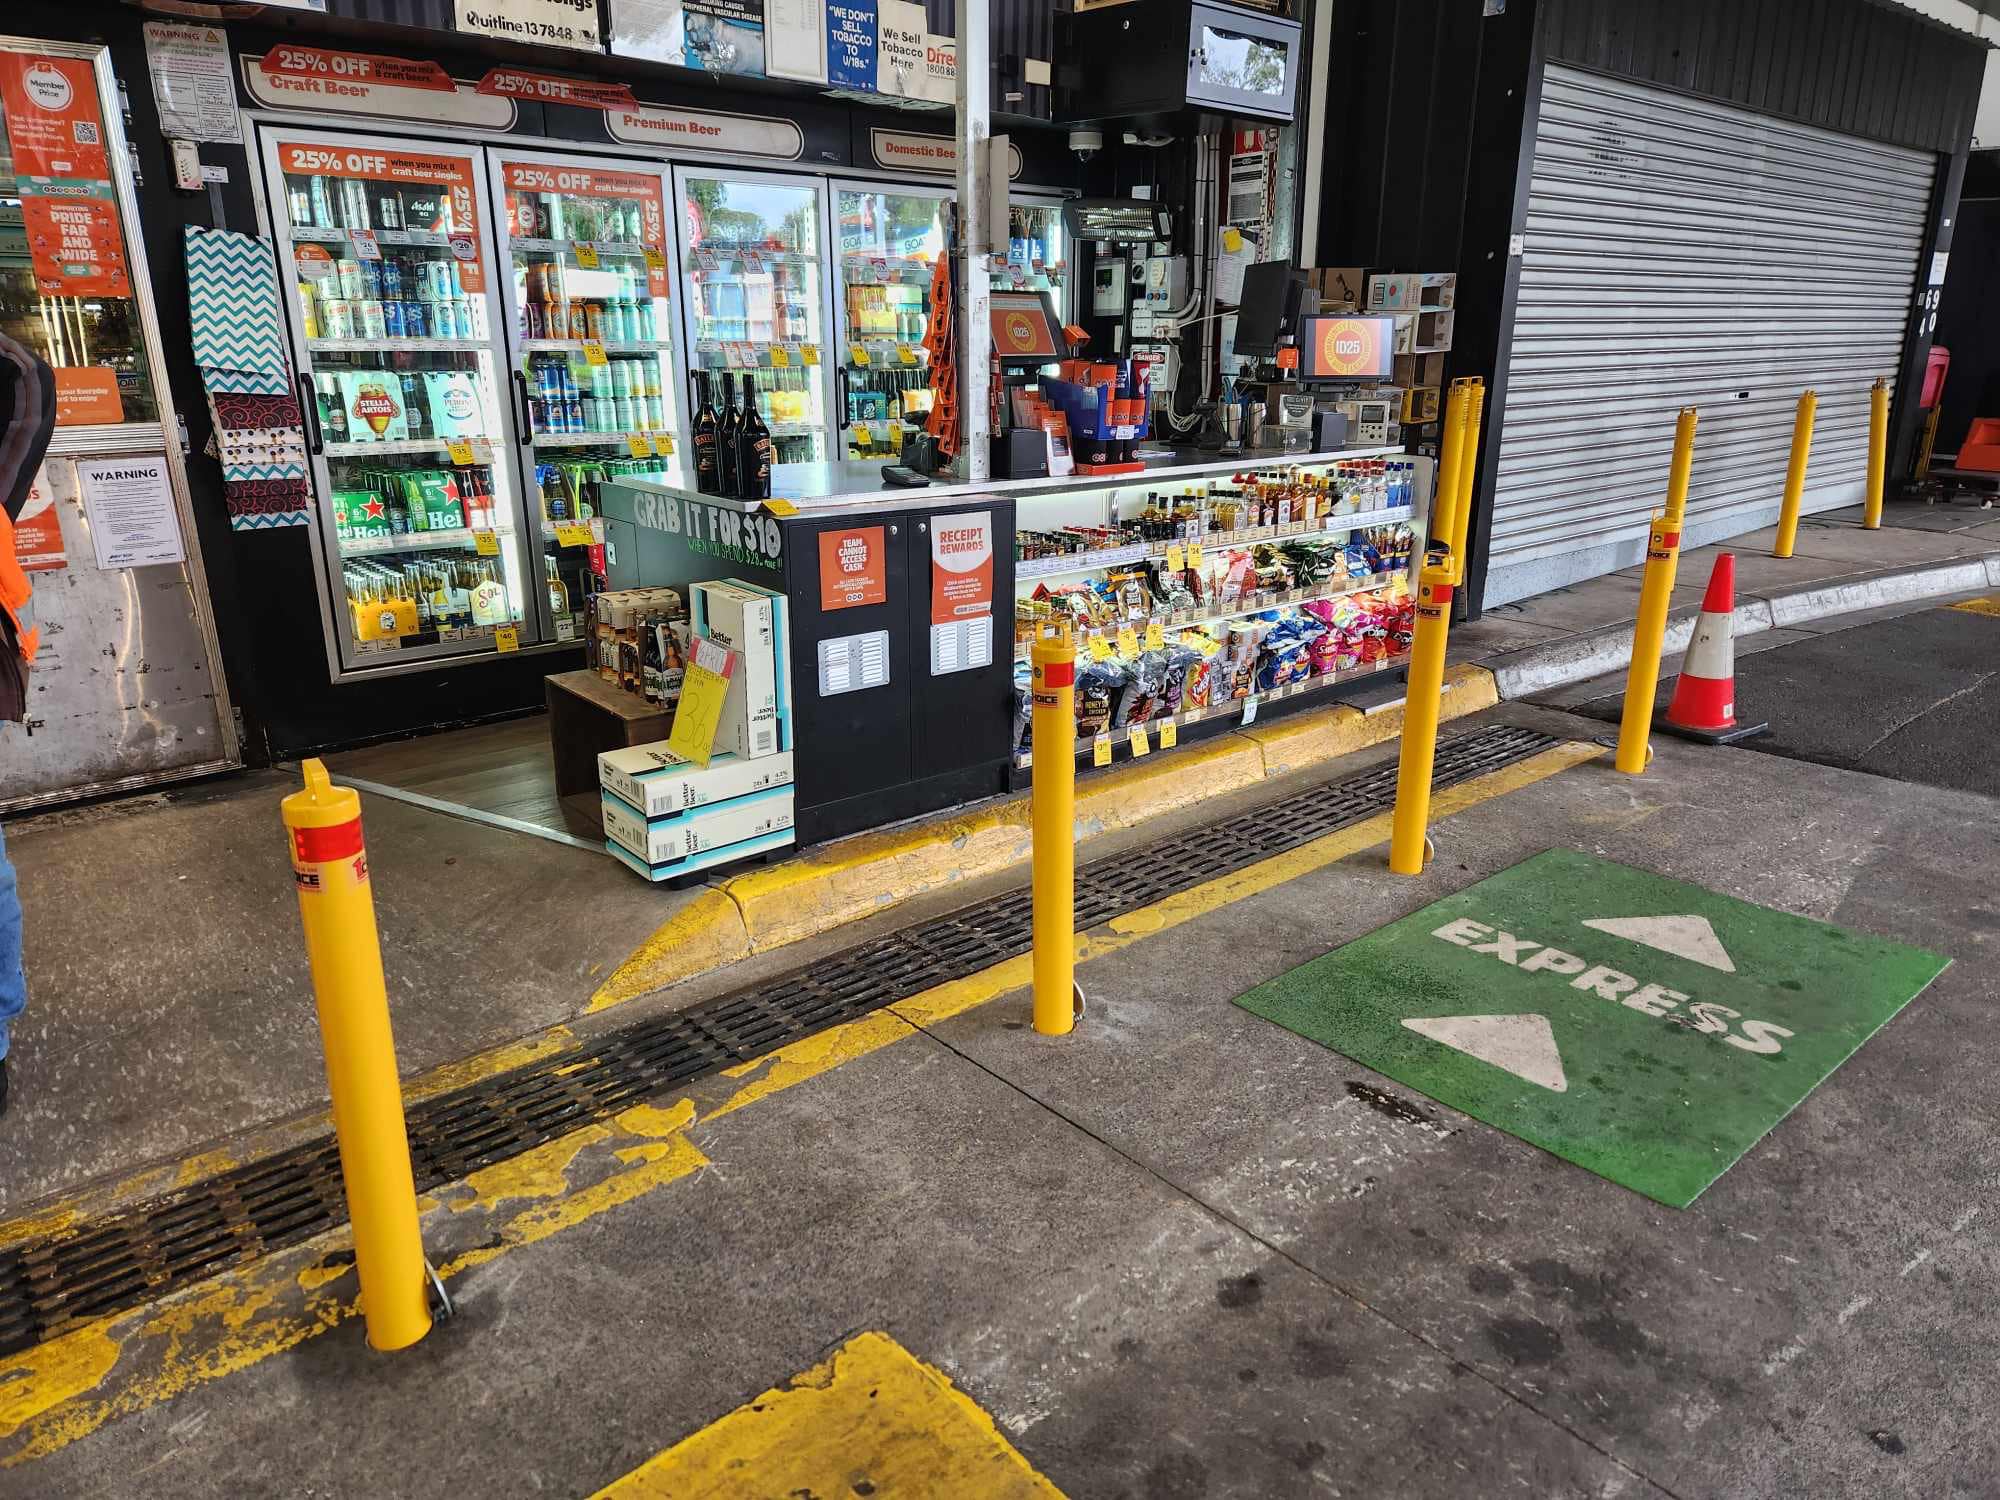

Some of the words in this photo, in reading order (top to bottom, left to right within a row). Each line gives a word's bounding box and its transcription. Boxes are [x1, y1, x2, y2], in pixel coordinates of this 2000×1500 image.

[724, 1, 745, 11] CAUSES
[713, 8, 741, 19] VASCULAR
[740, 12, 763, 23] DISEASE
[847, 9, 875, 24] DON'T
[841, 19, 863, 33] SELL
[149, 28, 201, 41] WARNING
[831, 29, 873, 47] TOBACCO
[882, 27, 900, 40] We
[901, 31, 922, 45] Sell
[846, 44, 859, 56] TO
[881, 40, 924, 58] Tobacco
[278, 50, 329, 73] 25%
[330, 56, 371, 77] OFF
[400, 64, 417, 74] you
[890, 55, 914, 70] Here
[30, 79, 65, 90] Member
[268, 75, 322, 94] Craft
[324, 80, 371, 98] Beer
[493, 73, 535, 95] 25%
[537, 79, 570, 99] OFF
[38, 88, 60, 98] Price
[622, 114, 687, 133] Premium
[688, 122, 722, 137] Beer
[885, 142, 935, 158] Domestic
[936, 146, 957, 159] Bee
[291, 149, 343, 171] 25%
[346, 153, 388, 174] OFF
[390, 159, 415, 169] when
[414, 161, 432, 171] you
[431, 162, 448, 171] mix
[391, 167, 412, 177] craft
[413, 169, 434, 179] beer
[433, 170, 464, 182] singles
[512, 168, 555, 189] 25%
[557, 172, 592, 190] OFF
[49, 211, 94, 225] PRIDE
[60, 223, 89, 236] FAR
[62, 237, 93, 249] AND
[61, 249, 99, 261] WIDE
[1924, 288, 1941, 311] 69
[360, 399, 391, 407] STELLA
[360, 406, 393, 414] ARTOIS
[90, 468, 159, 482] WARNING
[633, 491, 681, 534] GRAB
[684, 500, 702, 540] IT
[707, 506, 742, 550] FOR
[842, 537, 863, 548] TEAM
[940, 527, 983, 544] RECEIPT
[838, 545, 868, 557] CANNOT
[940, 540, 984, 555] REWARDS
[840, 554, 867, 565] ACCESS
[843, 562, 865, 573] CASH.
[1430, 917, 1795, 1054] EXPRESS
